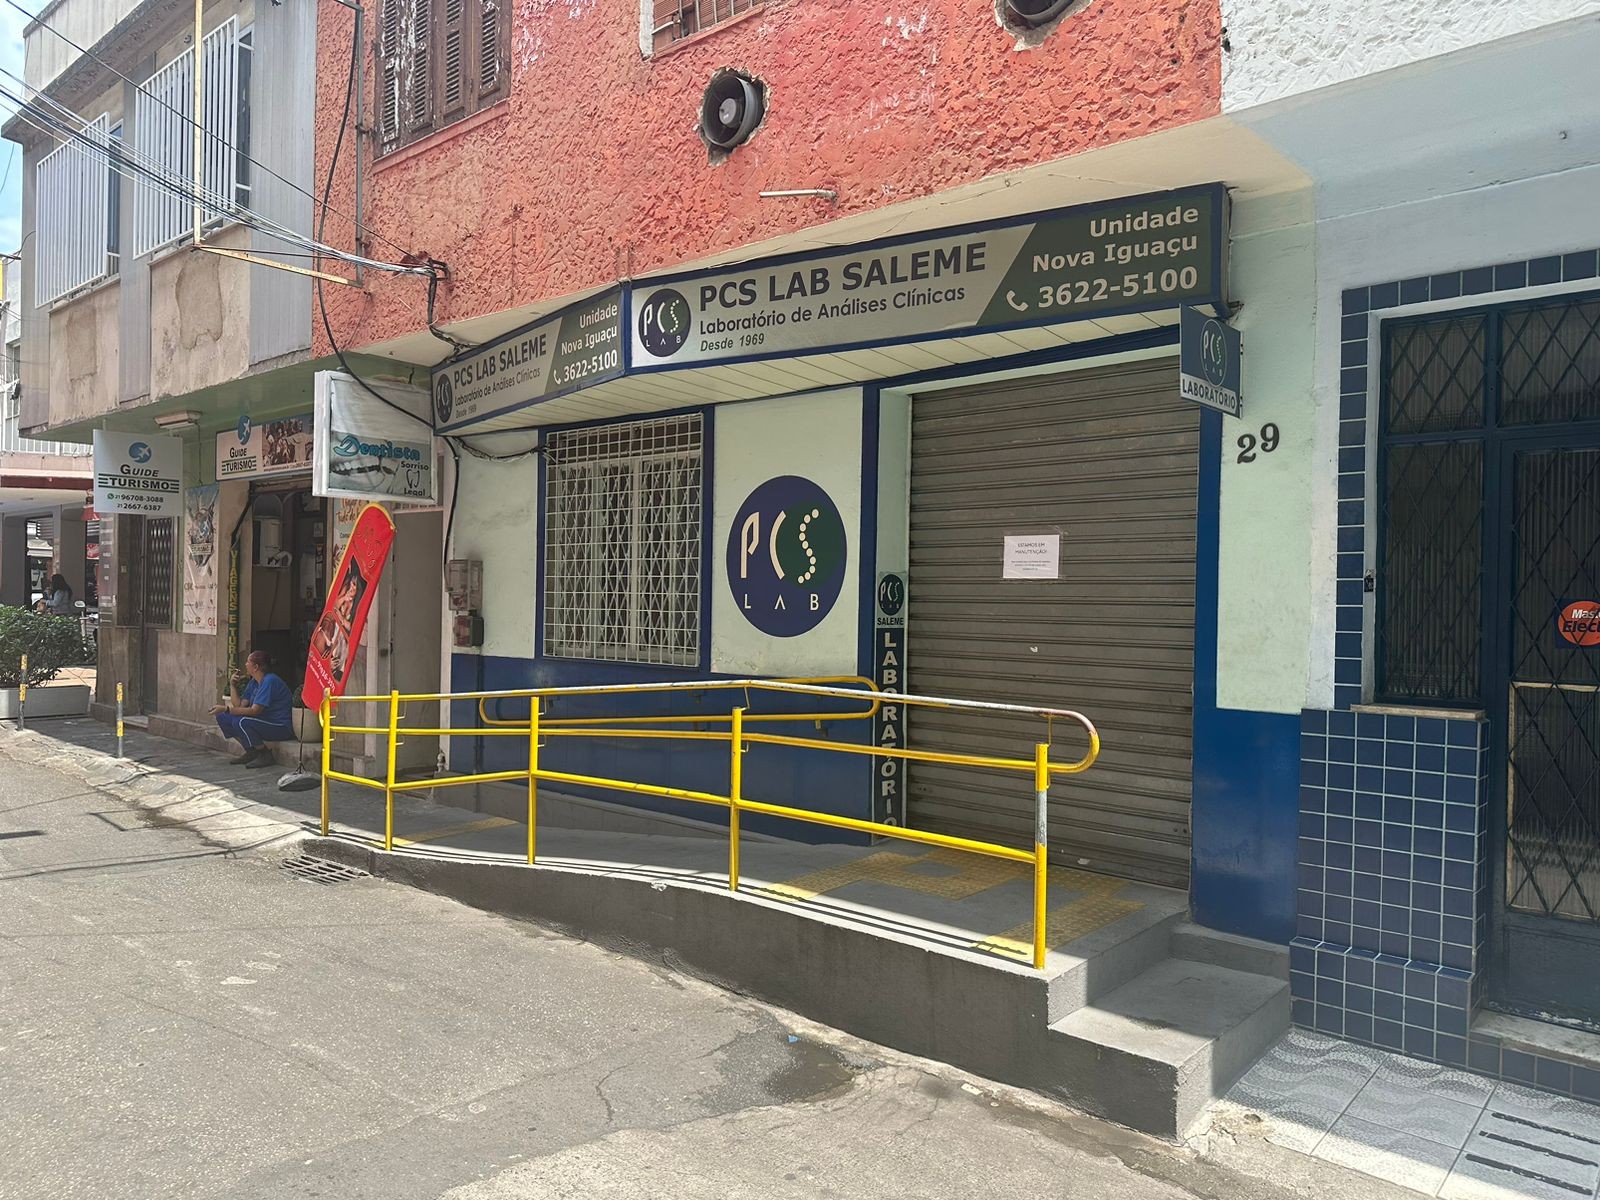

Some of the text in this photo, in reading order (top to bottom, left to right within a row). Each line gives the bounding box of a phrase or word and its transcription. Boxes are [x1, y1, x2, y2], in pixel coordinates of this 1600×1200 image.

[1090, 205, 1199, 237] Unidade
[1032, 235, 1197, 272] Nova Iguaçu
[700, 241, 987, 312] PCS LAB SALEME
[1038, 266, 1198, 309] 3622-5100
[579, 303, 618, 328] Unidade
[700, 285, 965, 335] Laboratório de Análises Clínicas
[561, 325, 618, 356] Nova Iguaçu
[700, 332, 765, 352] Desde 1969
[454, 333, 547, 390] PCS LAB SALEME
[563, 349, 618, 382] 3622-5100
[484, 383, 491, 396] de
[492, 375, 515, 393] Análises
[516, 367, 540, 384] Clínicas
[1182, 378, 1236, 410] LABORATÓRIO
[333, 434, 421, 461] Dentista
[1236, 422, 1280, 464] 29
[120, 464, 160, 477] GUIDE
[226, 460, 252, 472] TURISMO
[401, 460, 429, 471] Sorriso
[109, 477, 170, 490] TURISMO
[404, 488, 426, 496] Legal
[740, 508, 820, 584] PCS
[229, 550, 238, 611] VIAGENS
[744, 593, 819, 611] LAB
[229, 615, 237, 624] E
[877, 617, 904, 625] SALEME
